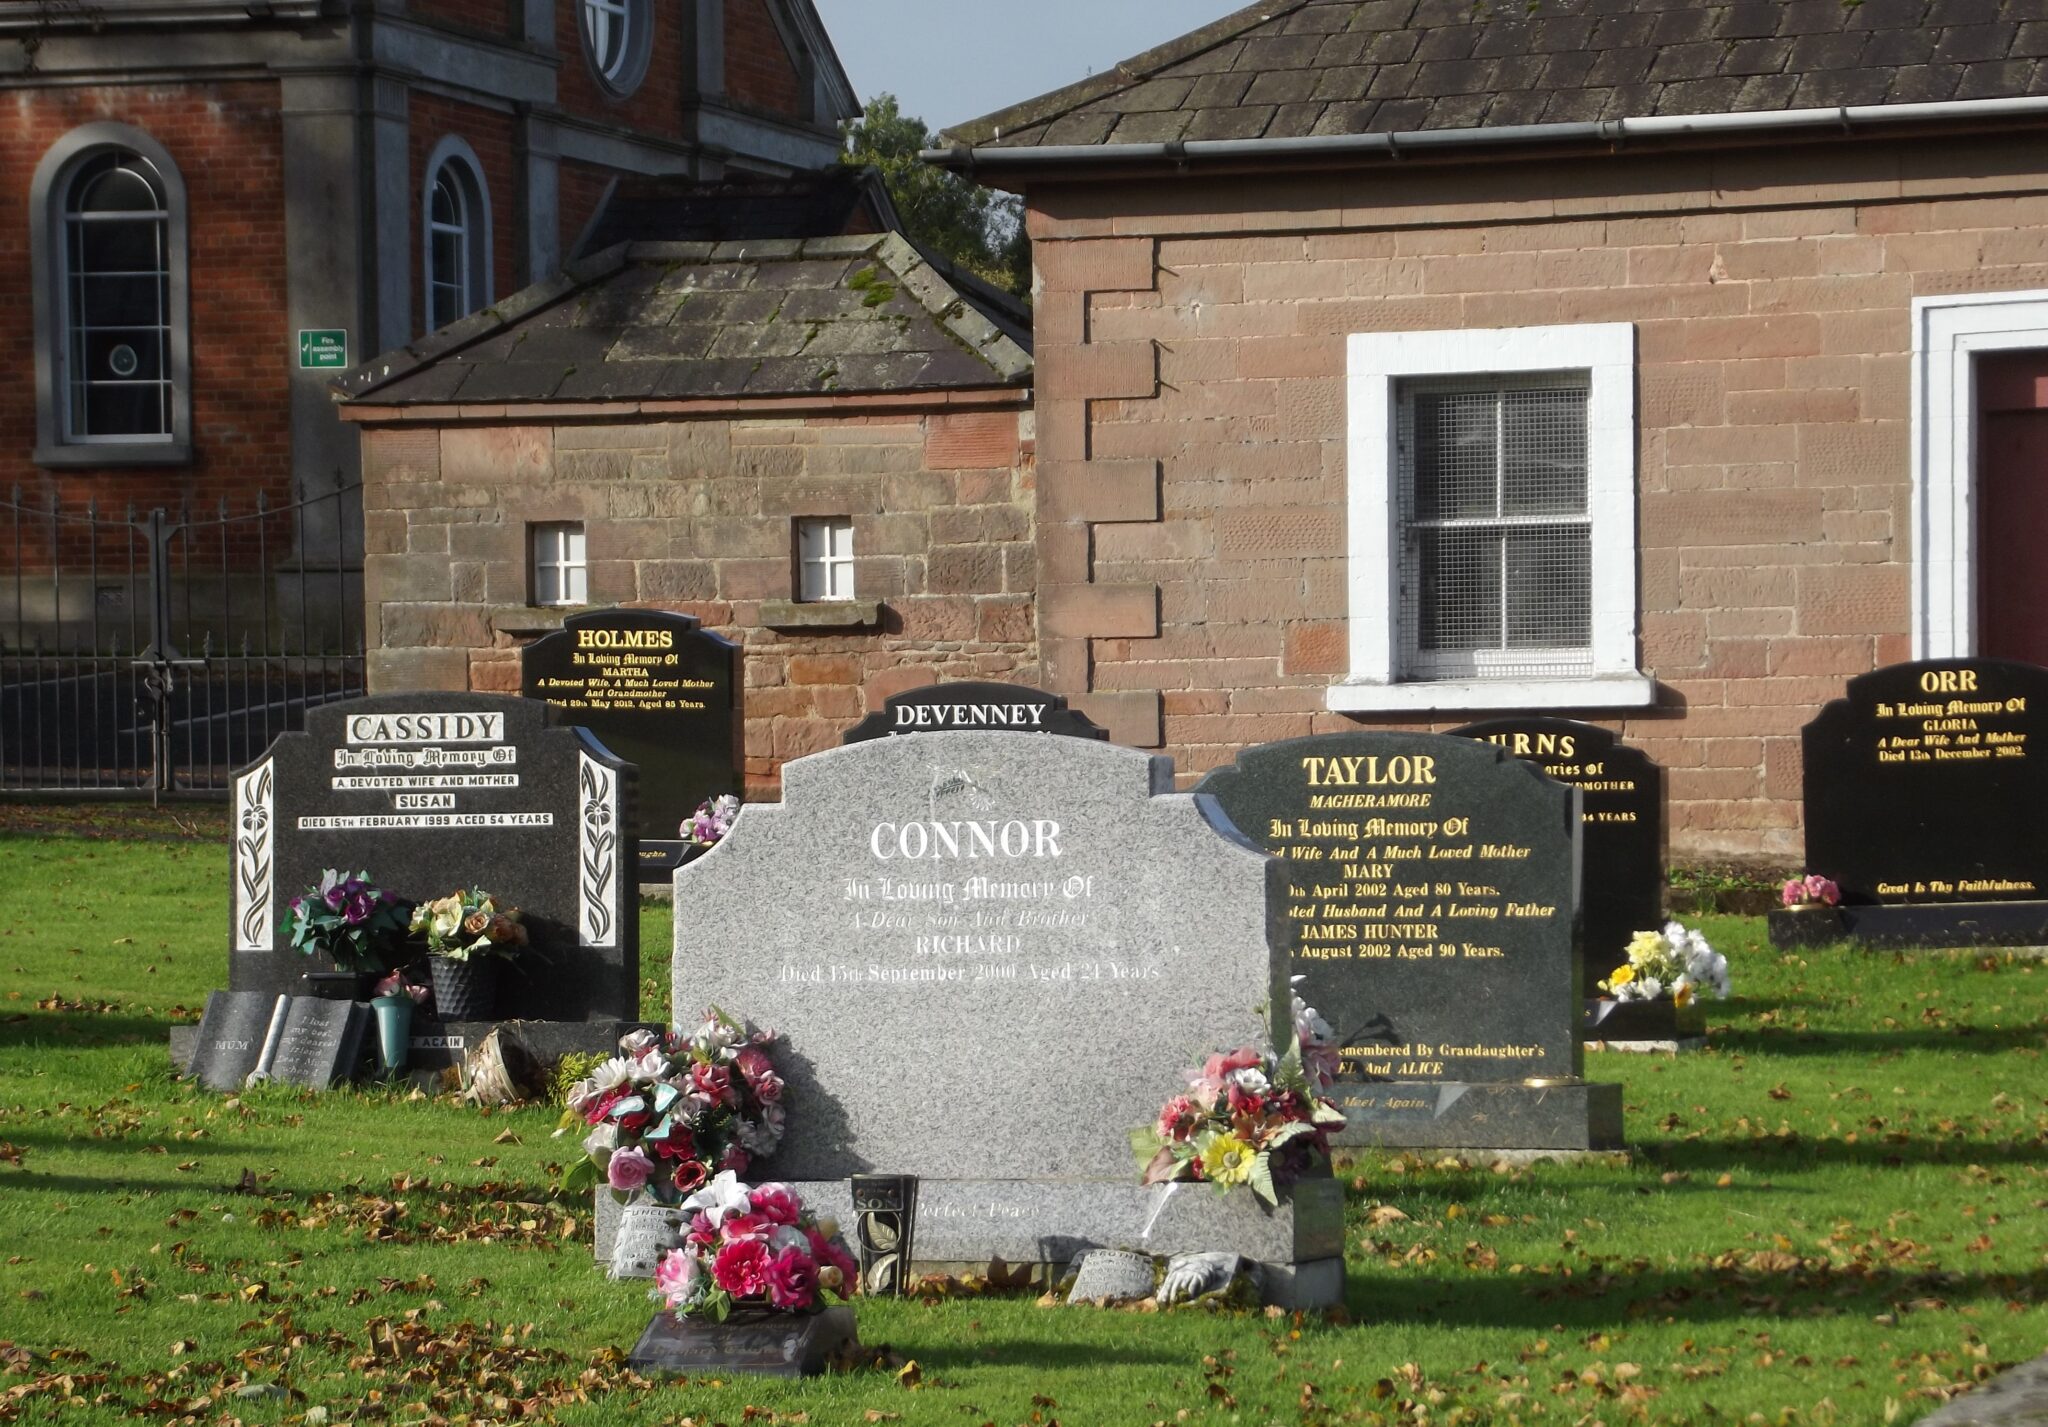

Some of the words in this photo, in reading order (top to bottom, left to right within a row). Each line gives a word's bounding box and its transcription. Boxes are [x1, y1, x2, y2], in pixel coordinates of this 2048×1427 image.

[578, 630, 673, 648] HOLMES
[573, 653, 585, 664] In
[588, 653, 621, 665] Loving
[623, 654, 662, 666] Memory
[665, 654, 678, 664] Of
[603, 668, 649, 676] MARTHA
[549, 678, 584, 686] Devoted
[614, 679, 621, 687] A
[624, 679, 648, 687] Much
[652, 679, 678, 687] Loved
[1921, 670, 1978, 692] ORR
[607, 690, 667, 698] Grandmother
[591, 700, 610, 708] May
[639, 700, 661, 709] Aged
[1876, 703, 1893, 717] In
[1897, 702, 1943, 717] Loving
[1947, 700, 2002, 715] Memory
[2006, 698, 2026, 712] Of
[895, 704, 1046, 725] DEVENNEY
[352, 714, 496, 740] CASSIDY
[1923, 719, 1977, 731] GLORIA
[1474, 733, 1575, 757] URNS
[1878, 738, 1886, 748] A
[1892, 737, 1920, 747] Dear
[1924, 735, 1950, 746] Wife
[1956, 733, 1980, 744] And
[1986, 732, 2026, 743] Mother
[336, 750, 355, 768] In
[362, 750, 414, 766] Loving
[423, 748, 486, 766] Memory
[492, 748, 514, 762] Of
[1879, 751, 1905, 761] Died
[1936, 747, 1990, 759] December
[1303, 755, 1437, 786] TAYLOR
[1585, 763, 1603, 775] Of
[337, 780, 345, 788] A
[350, 776, 402, 788] DEVOTED
[408, 776, 434, 786] WIFE
[440, 776, 464, 786] AND
[469, 776, 514, 786] MOTHER
[400, 796, 451, 808] SUSAN
[1310, 794, 1431, 808] MAGHERAMORE
[302, 818, 326, 827] DIED
[360, 816, 419, 826] FEBRUARY
[425, 816, 450, 826] 1999
[490, 816, 504, 824] 54
[510, 814, 550, 824] YEARS
[1599, 812, 1636, 821] YEARS
[1269, 819, 1292, 837] In
[1298, 819, 1358, 839] Loving
[1364, 819, 1438, 839] Memory
[1443, 817, 1469, 836] Of
[870, 820, 1063, 860] CONNOR
[1292, 846, 1323, 860] Wife
[1329, 846, 1358, 860] And
[1366, 847, 1377, 859] A
[1383, 846, 1422, 859] Much
[1429, 845, 1472, 858] Loved
[1480, 845, 1531, 858] Mother
[1344, 864, 1394, 879] MARY
[843, 878, 870, 900] In
[879, 877, 955, 904] Loving
[962, 876, 1053, 901] Memory
[1062, 875, 1093, 899] Of
[1312, 883, 1348, 898] April
[1355, 884, 1387, 897] 2002
[1393, 884, 1428, 897] Aged
[1435, 883, 1451, 896] 80
[1878, 882, 1908, 893] Great
[1915, 882, 1926, 892] Is
[1930, 881, 1952, 893] Thy
[1323, 904, 1386, 918] Husband
[1394, 904, 1422, 917] And
[1431, 904, 1441, 916] A
[1449, 905, 1498, 918] Loving
[1506, 903, 1556, 916] Father
[1017, 910, 1089, 928] Brother
[1301, 925, 1357, 939] JAMES
[1364, 924, 1439, 939] HUNTER
[916, 935, 1020, 955] RICHARD
[1301, 945, 1352, 959] August
[1359, 945, 1390, 957] 2002
[1397, 945, 1432, 958] Aged
[1439, 944, 1456, 956] 90
[781, 965, 820, 982] Died
[868, 964, 966, 984] September
[1026, 963, 1071, 982] Aged
[1109, 961, 1159, 980] Years
[216, 1041, 249, 1049] MUM
[423, 1038, 460, 1047] AGAIN
[1339, 1044, 1410, 1056] emembered
[1418, 1044, 1433, 1057] By
[1439, 1044, 1545, 1058] Grandaughter's
[1365, 1062, 1391, 1074] And
[1399, 1062, 1443, 1074] ALICE
[857, 1199, 897, 1208] SON
